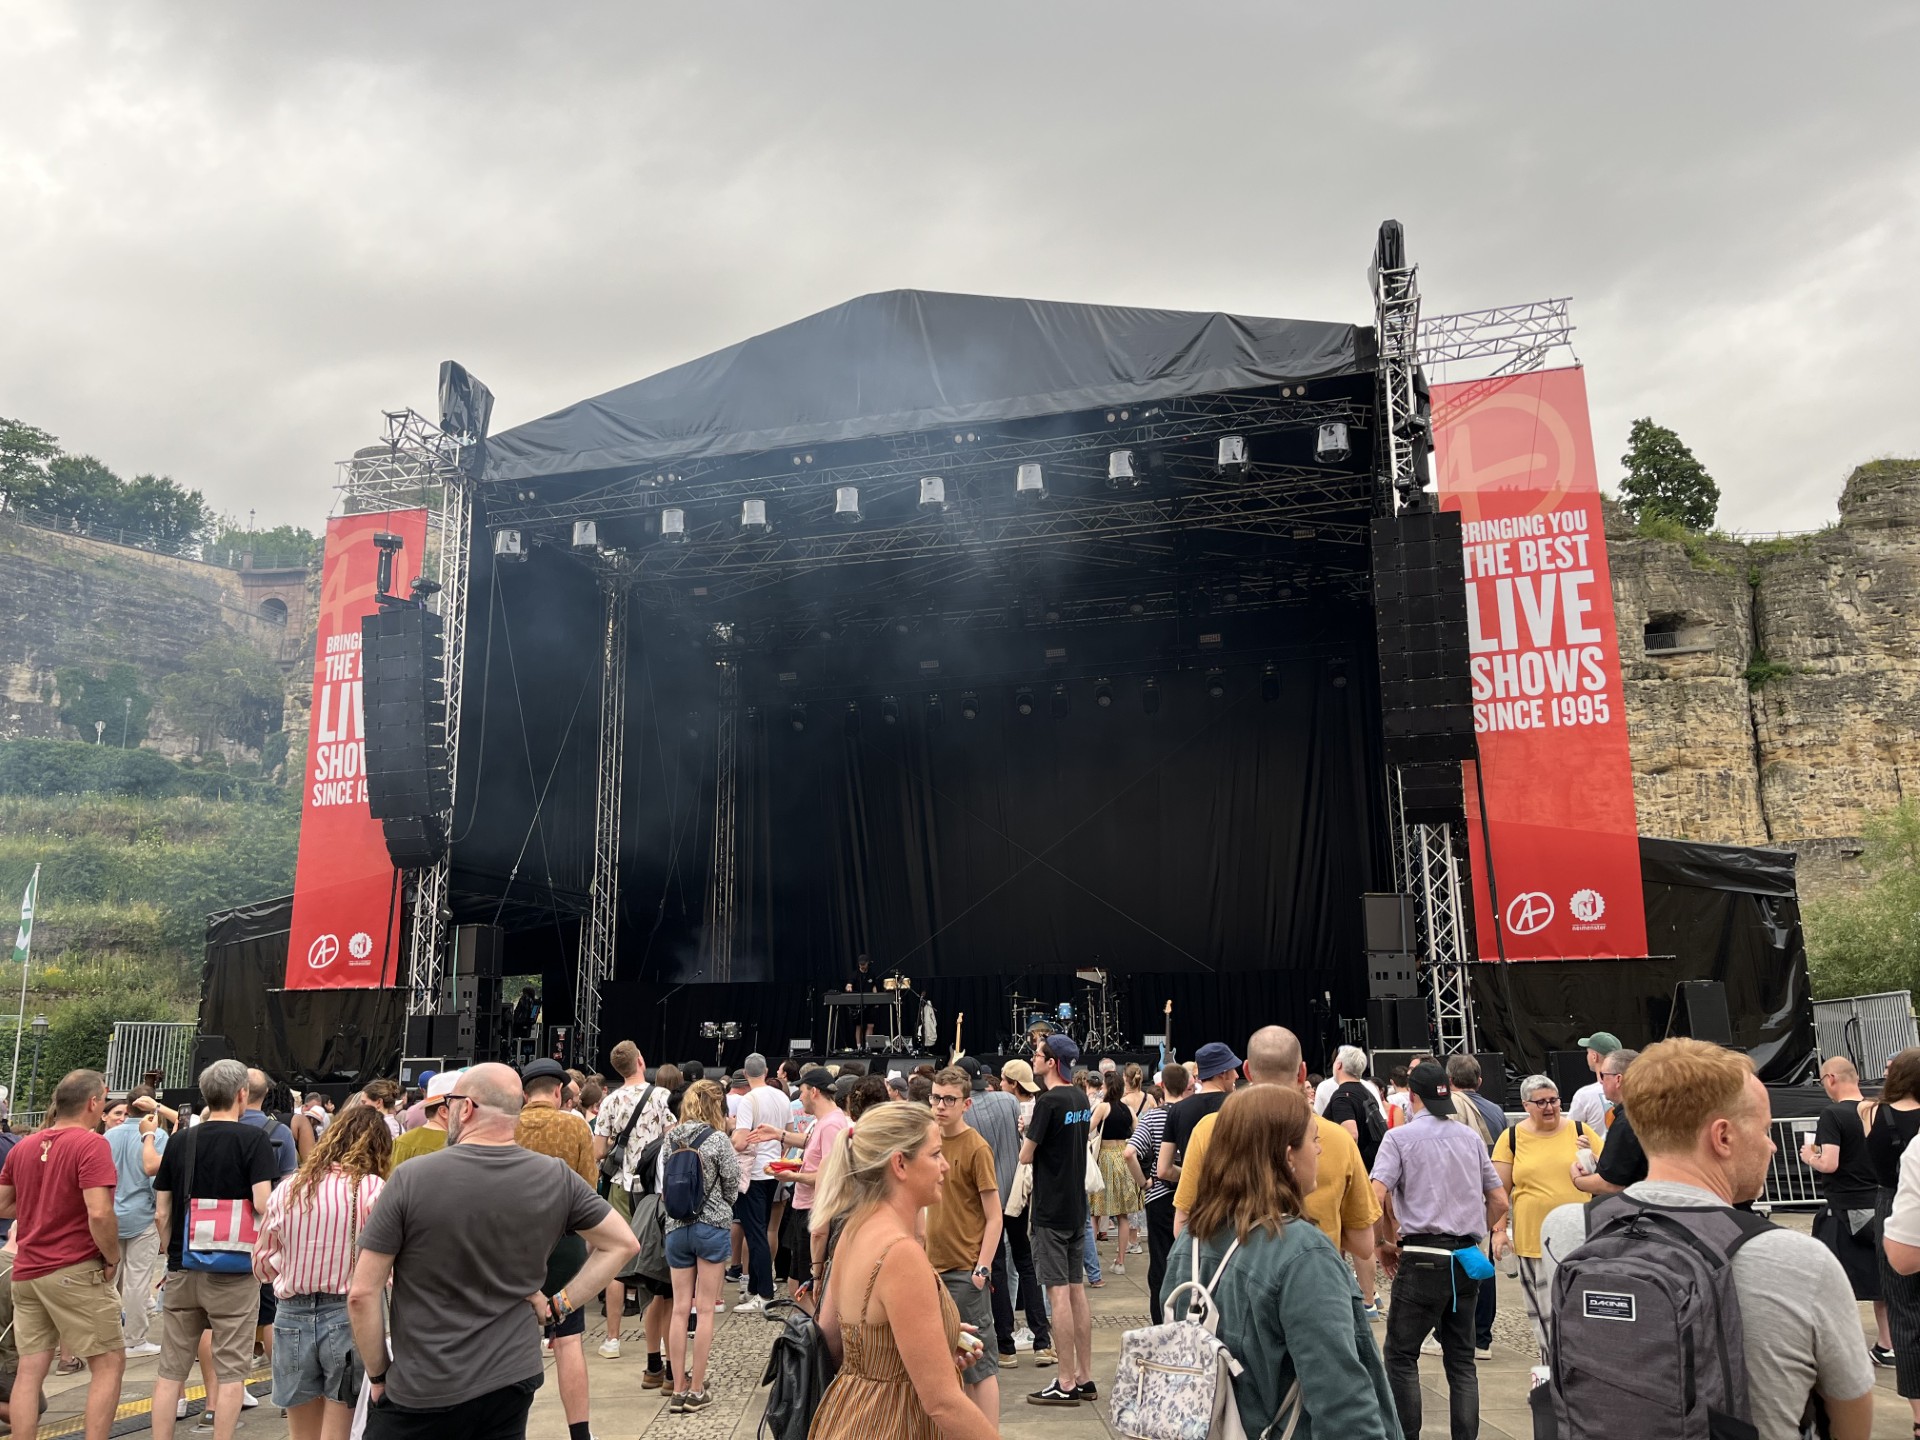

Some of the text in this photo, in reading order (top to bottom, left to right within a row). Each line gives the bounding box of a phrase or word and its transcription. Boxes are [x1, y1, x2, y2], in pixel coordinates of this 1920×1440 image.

[1461, 509, 1588, 544] BRINGING YOU
[1463, 534, 1590, 579] THE BEST
[1465, 569, 1601, 654] LIVE
[324, 652, 355, 682] THE
[1470, 646, 1607, 700] SHOWS
[1473, 694, 1610, 733] SINCE 1995
[314, 742, 367, 781] SHO
[312, 780, 354, 807] SINCE
[1589, 1300, 1629, 1308] DAKINE
